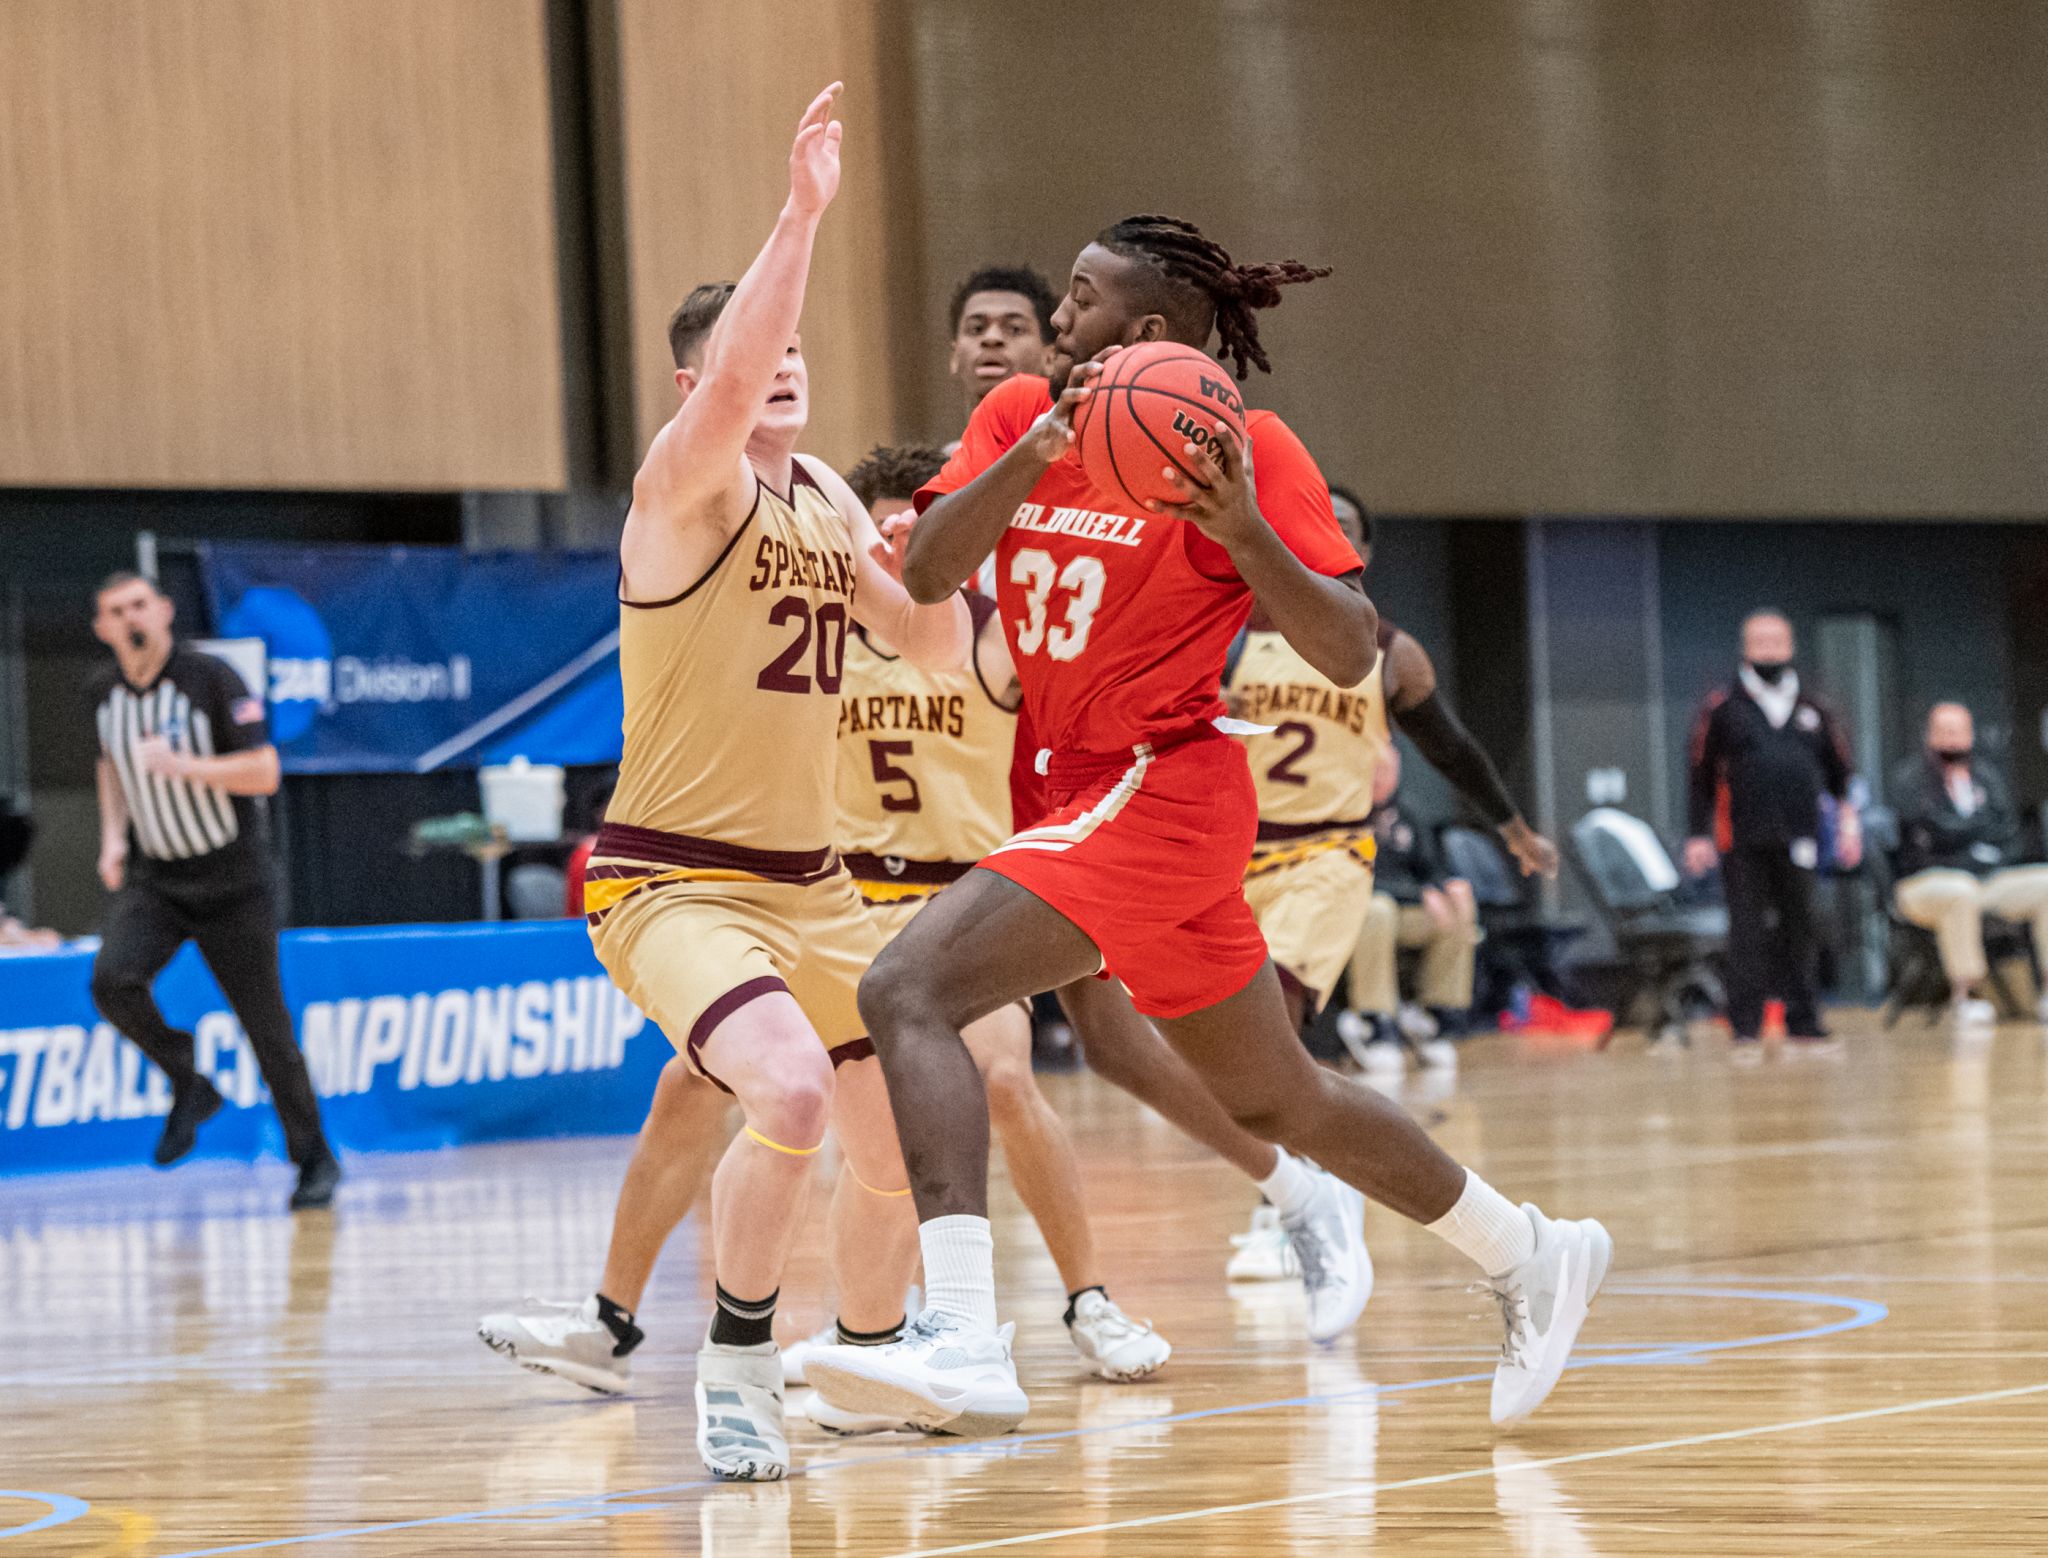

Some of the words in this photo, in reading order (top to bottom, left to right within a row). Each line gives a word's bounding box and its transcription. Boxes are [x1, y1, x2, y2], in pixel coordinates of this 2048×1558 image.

[1009, 502, 1147, 547] ALDWELL
[1010, 547, 1108, 662] 33
[757, 595, 847, 694] 20
[837, 695, 965, 740] PARTANS
[867, 739, 922, 813] 5
[1267, 720, 1316, 785] 2
